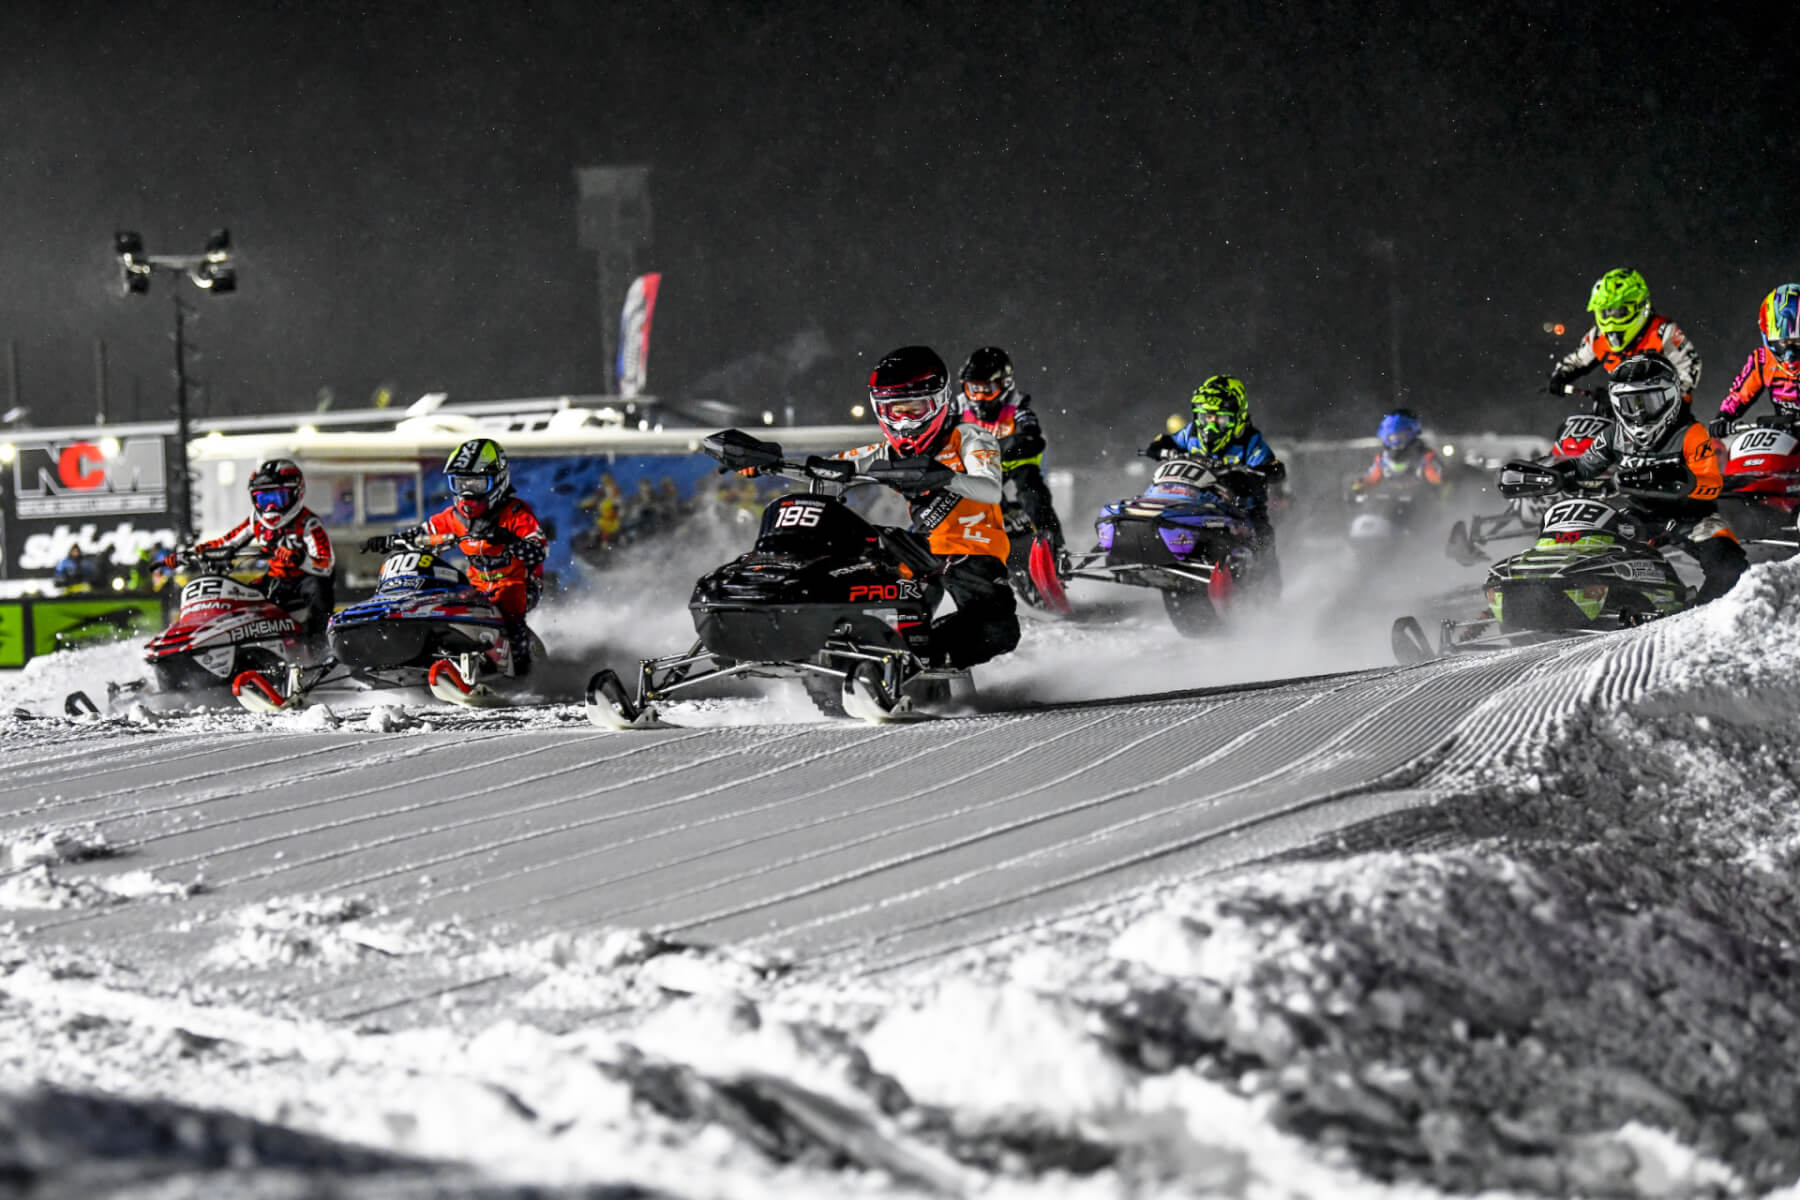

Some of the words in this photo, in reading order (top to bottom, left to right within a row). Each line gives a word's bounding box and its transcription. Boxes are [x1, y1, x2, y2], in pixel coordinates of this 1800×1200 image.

[1739, 432, 1780, 451] 005
[15, 437, 165, 498] NCM
[1159, 463, 1206, 481] 100
[774, 505, 823, 528] 195
[184, 579, 222, 601] 22
[849, 585, 898, 602] PRO
[231, 618, 296, 642] BIKEMAN
